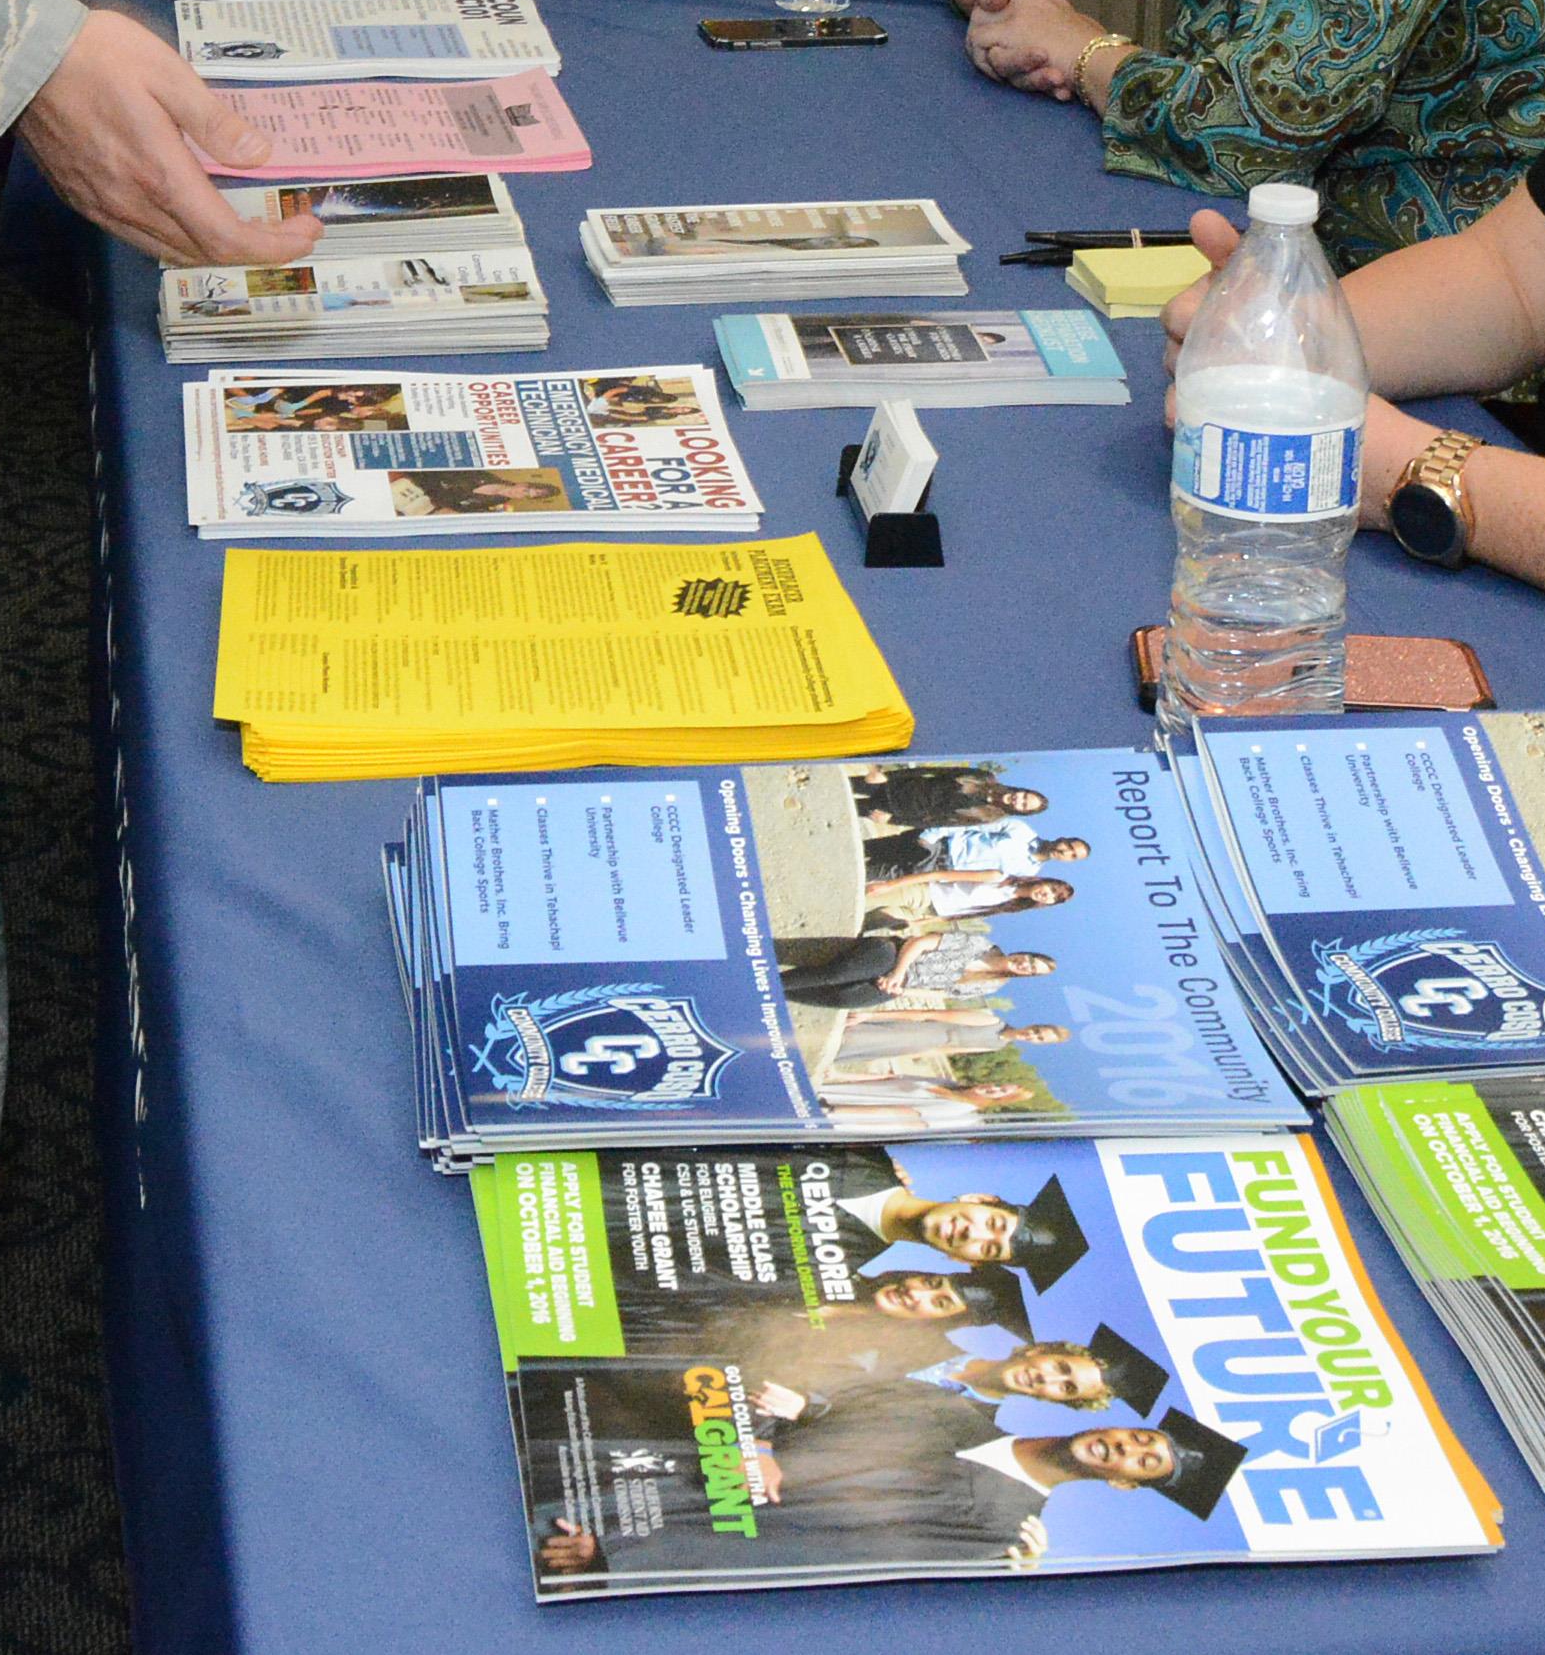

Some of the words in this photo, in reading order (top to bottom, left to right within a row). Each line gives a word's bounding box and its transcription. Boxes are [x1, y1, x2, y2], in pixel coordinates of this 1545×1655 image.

[467, 382, 510, 465] OPPORTUNITIES
[489, 381, 520, 424] CAREER
[516, 381, 564, 454] TECHNICIAN
[544, 380, 594, 455] EMERGENCY
[570, 457, 615, 510] MEDICAL
[594, 431, 663, 511] CAREER?
[645, 457, 698, 494] FOR
[674, 427, 747, 508] LOOKING
[661, 499, 704, 509] A
[748, 550, 778, 591] PLACEMENT
[761, 593, 785, 616] EXAM
[1460, 726, 1495, 781] Opening
[1484, 785, 1515, 825] Doors
[469, 810, 482, 831] Back
[486, 809, 500, 844] Mather
[535, 808, 550, 845] Classes
[648, 805, 665, 843] College
[665, 805, 680, 832] CCCC
[718, 780, 742, 834] Opening
[1108, 770, 1175, 866] Report
[583, 806, 602, 858] University
[600, 806, 620, 866] Partnership
[471, 835, 486, 875] College
[540, 847, 555, 880] Thrive
[668, 835, 689, 894] Designated
[728, 837, 749, 877] Doors
[476, 879, 490, 912] Sports
[544, 883, 556, 893] in
[609, 870, 623, 895] with
[1140, 876, 1182, 907] To
[496, 899, 508, 917] Inc.
[545, 897, 563, 950] Tehachapi
[612, 897, 630, 942] Bellevue
[679, 897, 697, 933] Leader
[737, 891, 763, 955] Changing
[497, 921, 511, 949] Bring
[1155, 921, 1202, 967] The
[750, 959, 772, 991] Lives
[1388, 976, 1497, 1017] CC
[1416, 940, 1529, 997] CERRO
[1487, 1000, 1535, 1039] COSO
[1327, 953, 1390, 1008] COMMUNITY
[1370, 1009, 1404, 1042] COLLEGE
[505, 1008, 549, 1064] COMMUNITY
[607, 998, 703, 1057] CERRO
[759, 1003, 790, 1058] Improving
[1060, 985, 1231, 1106] 2016
[1175, 977, 1275, 1102] Community
[554, 1034, 665, 1075] CC
[520, 1066, 550, 1100] COLLEGE
[629, 1061, 704, 1100] COSO
[776, 1061, 812, 1117] Communities
[1409, 1114, 1439, 1136] ON
[1431, 1113, 1488, 1182] FINANCIAL
[1474, 1186, 1505, 1209] AID
[1452, 1112, 1490, 1152] APPLY
[1478, 1155, 1509, 1182] FOR
[515, 1163, 533, 1187] ON
[560, 1162, 580, 1208] APPLY
[620, 1163, 636, 1185] FOR
[674, 1163, 691, 1186] CSU
[693, 1163, 709, 1185] FOR
[736, 1163, 764, 1228] MIDDLE
[775, 1165, 793, 1187] THE
[1424, 1139, 1485, 1212] OCTOBER
[537, 1162, 561, 1242] FINANCIAL
[622, 1188, 642, 1231] FOSTER
[640, 1163, 668, 1231] CHAFEE
[680, 1199, 695, 1216] UC
[697, 1188, 718, 1235] ELIGIBLE
[1230, 1150, 1337, 1286] FUND
[517, 1192, 543, 1273] OCTOBER
[566, 1212, 584, 1242] FOR
[712, 1163, 751, 1281] SCHOLARSHIP
[778, 1191, 808, 1263] CALIFORNIA
[799, 1182, 854, 1301] EXPLORE!
[1471, 1215, 1493, 1227] 1,
[546, 1246, 565, 1271] AID
[629, 1233, 649, 1270] YOUTH
[650, 1235, 677, 1290] GRANT
[683, 1219, 705, 1273] STUDENTS
[748, 1232, 775, 1282] CLASS
[1481, 1229, 1519, 1259] 2016
[525, 1277, 544, 1289] 1,
[569, 1246, 593, 1307] STUDENT
[795, 1266, 818, 1305] DREAM
[529, 1291, 548, 1324] 2016
[550, 1274, 575, 1341] BEGINNING
[806, 1310, 824, 1330] ACT
[1111, 1151, 1384, 1527] FUTURE
[1283, 1289, 1397, 1410] YOUR
[725, 1366, 740, 1383] GO
[729, 1385, 744, 1400] TO
[732, 1403, 756, 1458] COLLEGE
[744, 1461, 764, 1492] WITH
[627, 1479, 646, 1518] STUDENT
[642, 1478, 663, 1529] CALIFORNIA
[751, 1494, 766, 1505] A
